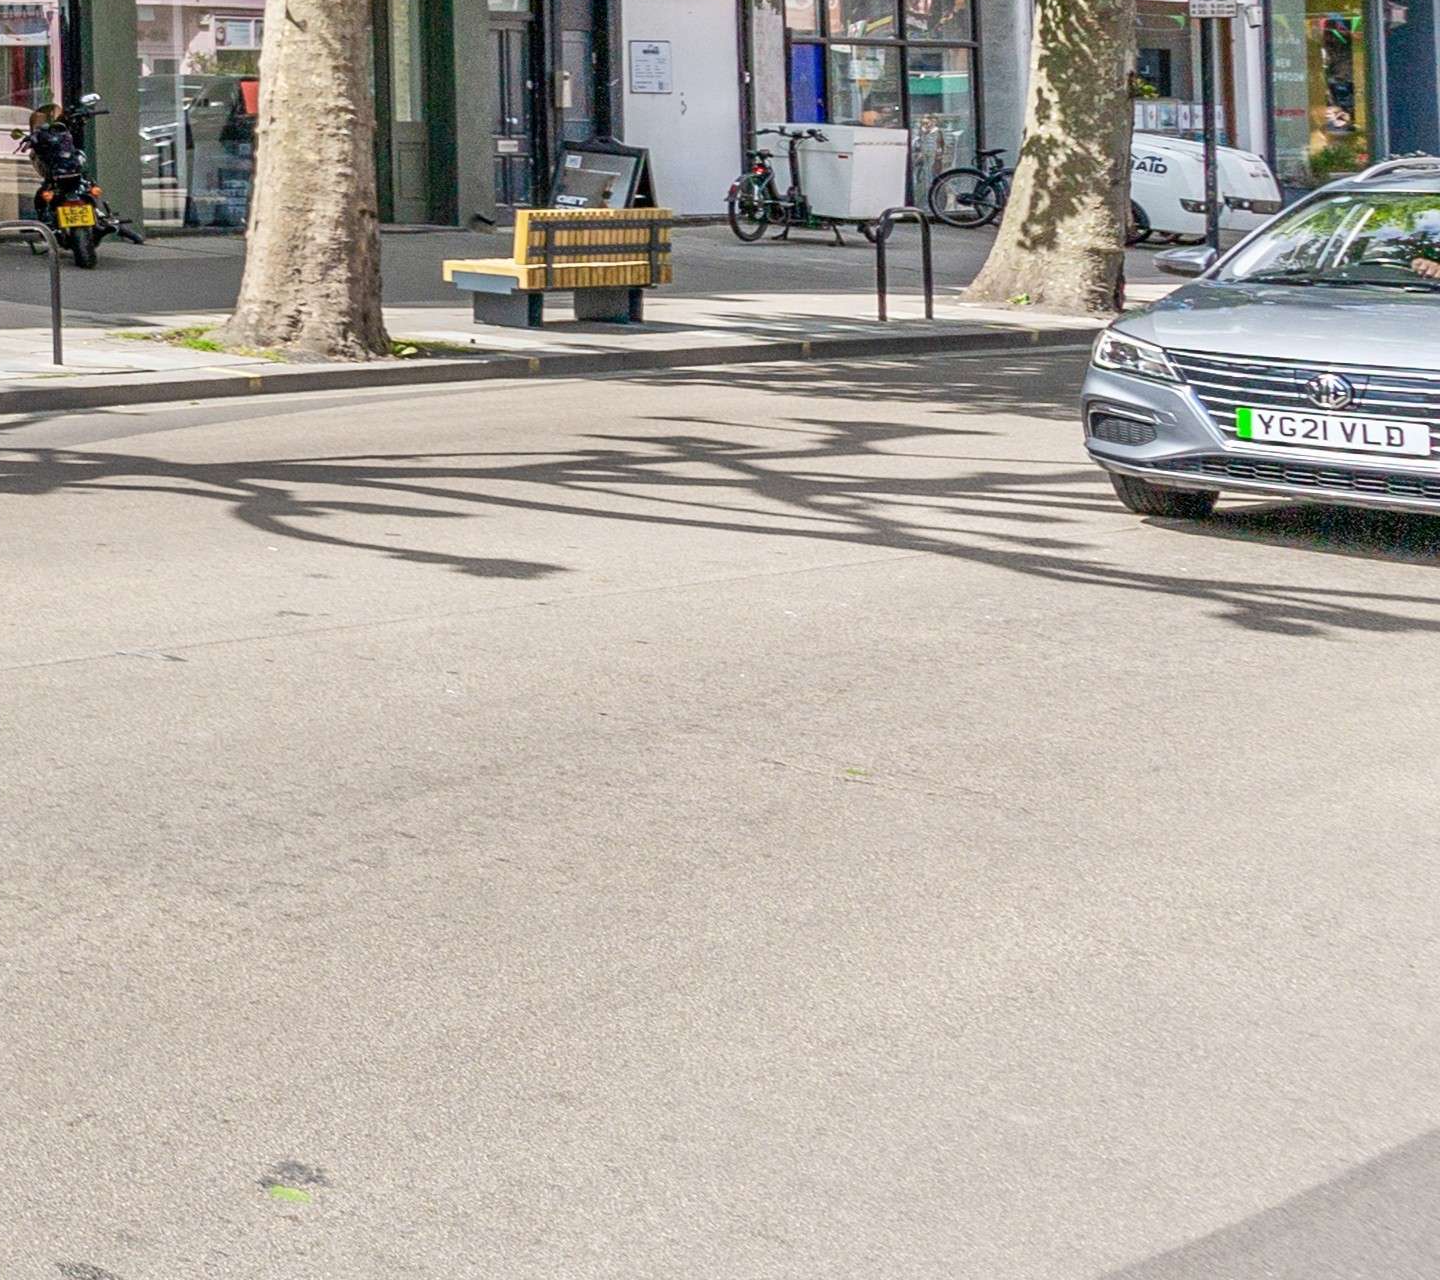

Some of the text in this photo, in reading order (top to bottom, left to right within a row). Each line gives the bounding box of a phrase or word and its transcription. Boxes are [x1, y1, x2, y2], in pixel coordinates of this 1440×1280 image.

[1131, 160, 1168, 175] AID
[1257, 413, 1405, 448] YG21 VLD
